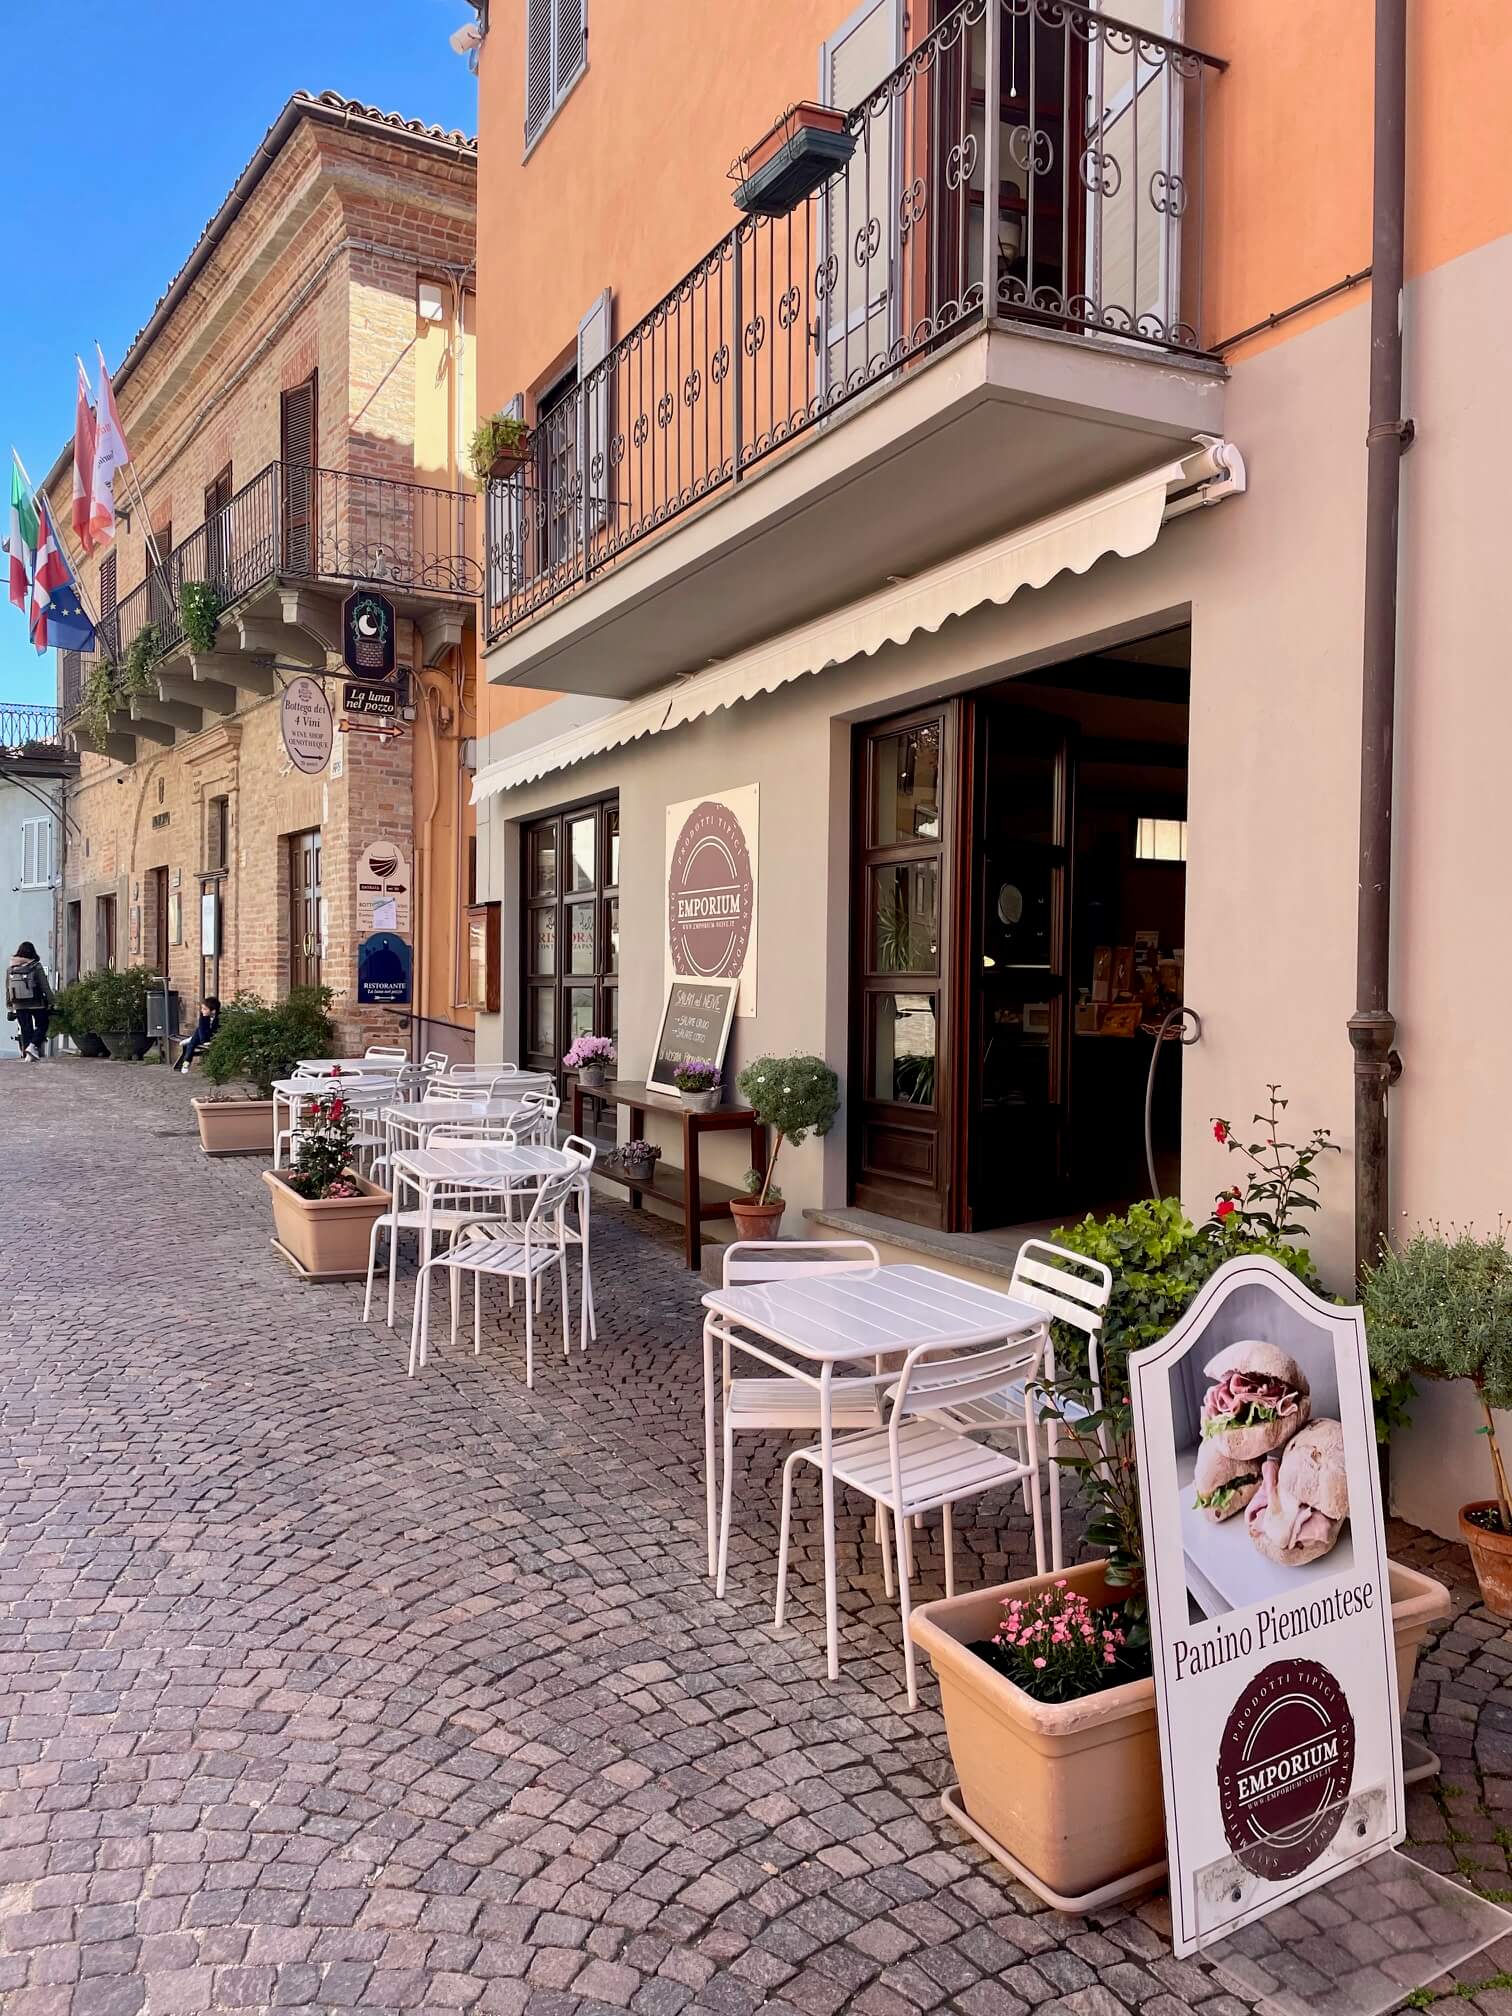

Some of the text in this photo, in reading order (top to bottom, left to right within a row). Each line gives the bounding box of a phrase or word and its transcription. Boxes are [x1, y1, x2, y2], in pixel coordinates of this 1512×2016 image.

[285, 700, 326, 715] Bottega dei
[346, 699, 394, 712] nel pozzo
[350, 688, 391, 703] La luna
[294, 715, 321, 728] 4 Vini
[677, 815, 742, 865] PRODOTTI TIPICI
[678, 893, 741, 918] EMPORIUM
[1172, 1582, 1374, 1682] Panino Piemontese
[1232, 1672, 1336, 1742] PRODOTTI TIPICI
[1237, 1737, 1339, 1801] EMPORIUM
